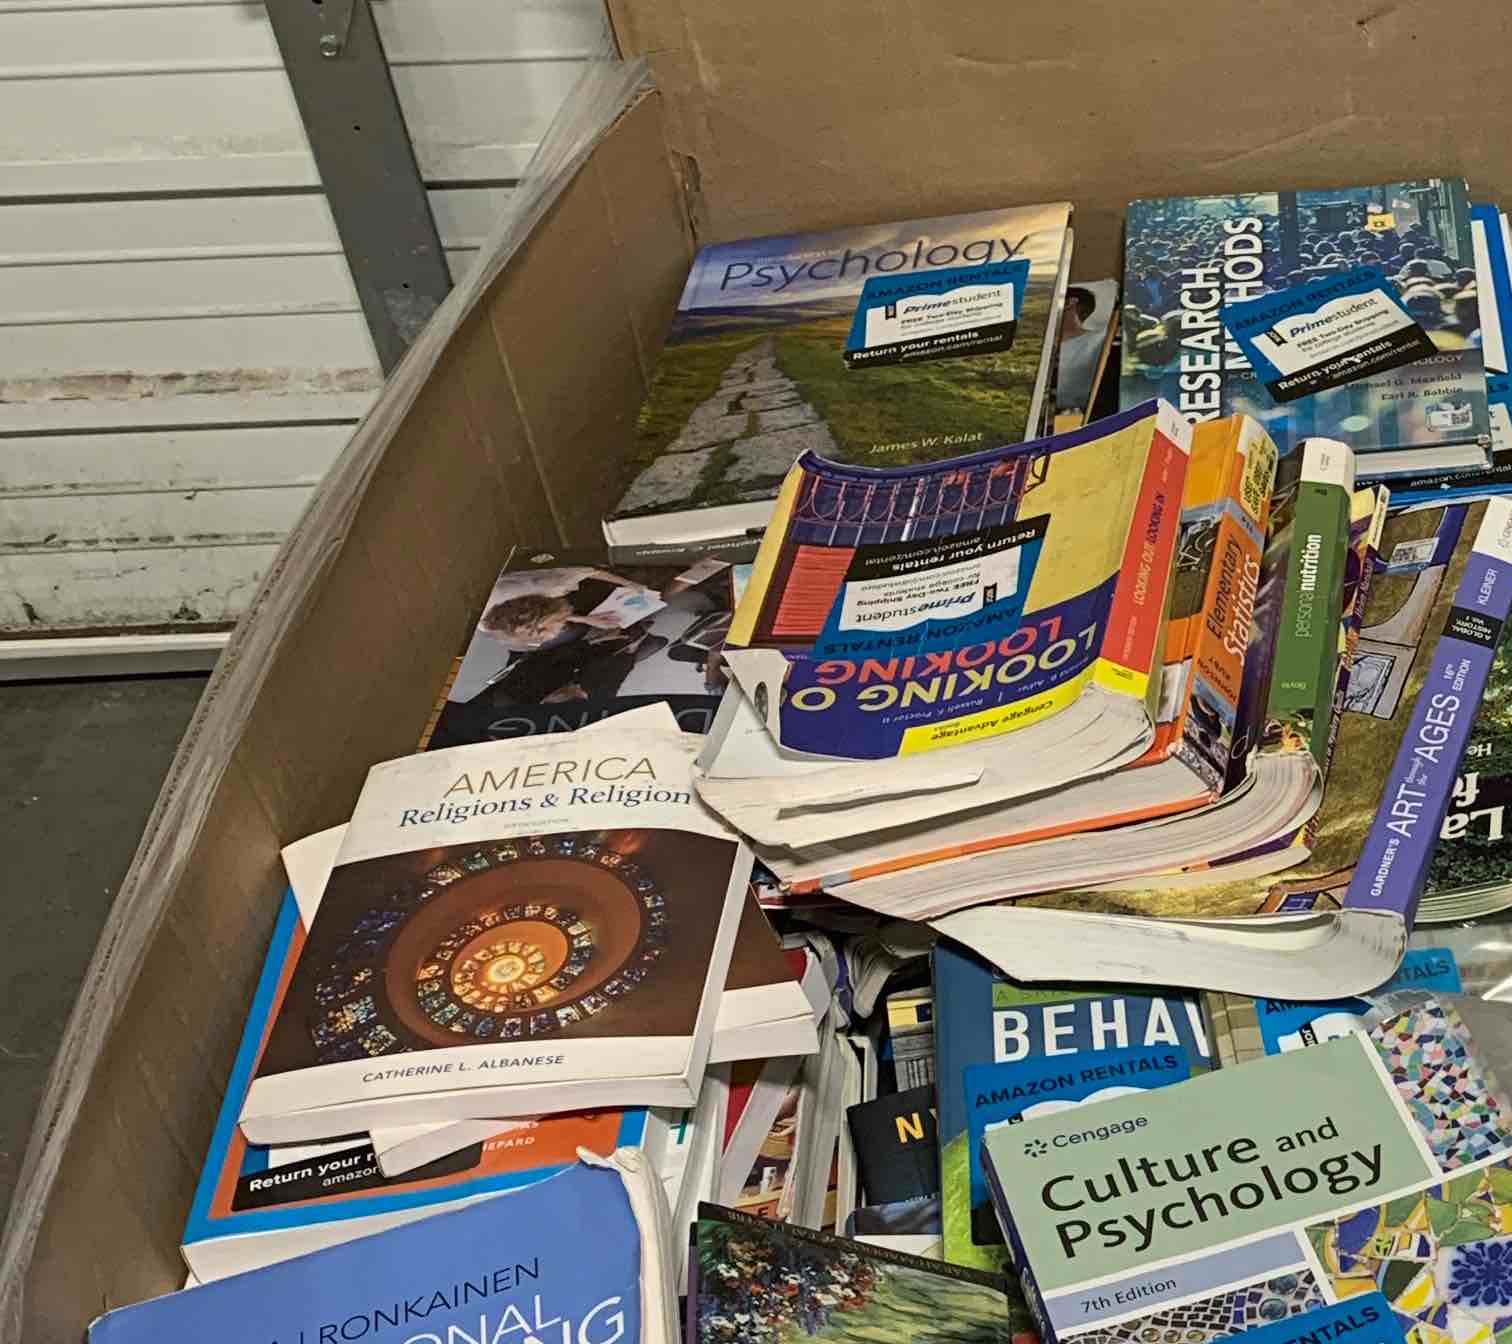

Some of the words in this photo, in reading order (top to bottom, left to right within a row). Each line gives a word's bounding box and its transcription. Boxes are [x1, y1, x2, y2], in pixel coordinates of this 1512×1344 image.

[720, 233, 1032, 293] Psychology
[1179, 268, 1222, 425] RESEARCH
[869, 441, 919, 456] James
[943, 432, 984, 446] Kalat
[1206, 535, 1242, 641] Elementary
[1222, 554, 1261, 667] Statistics
[1477, 568, 1499, 607] KLEINER
[815, 615, 1064, 686] LOOKING
[856, 622, 1098, 713] LOOKING
[1452, 658, 1472, 692] EDITION
[1001, 701, 1054, 724] Cengage
[1413, 692, 1461, 764] AGES
[443, 757, 657, 799] AMERICA
[399, 797, 531, 828] Religions
[540, 792, 560, 808] &
[1371, 838, 1401, 898] GARDNER'S
[1386, 781, 1428, 838] ART
[361, 1062, 454, 1084] CATHERINE
[458, 1060, 472, 1073] L.
[478, 1053, 566, 1072] ALBANESE
[973, 1072, 1075, 1109] AMAZON
[1079, 1054, 1179, 1086] RENTALS
[1052, 1113, 1150, 1150] Cengage
[249, 1167, 313, 1193] Return
[318, 1154, 362, 1182] your
[1041, 1131, 1260, 1213] Culture
[1275, 1116, 1340, 1153] and
[1056, 1143, 1386, 1259] Psychology
[1079, 1293, 1112, 1316] 7th
[1113, 1275, 1178, 1308] Edition
